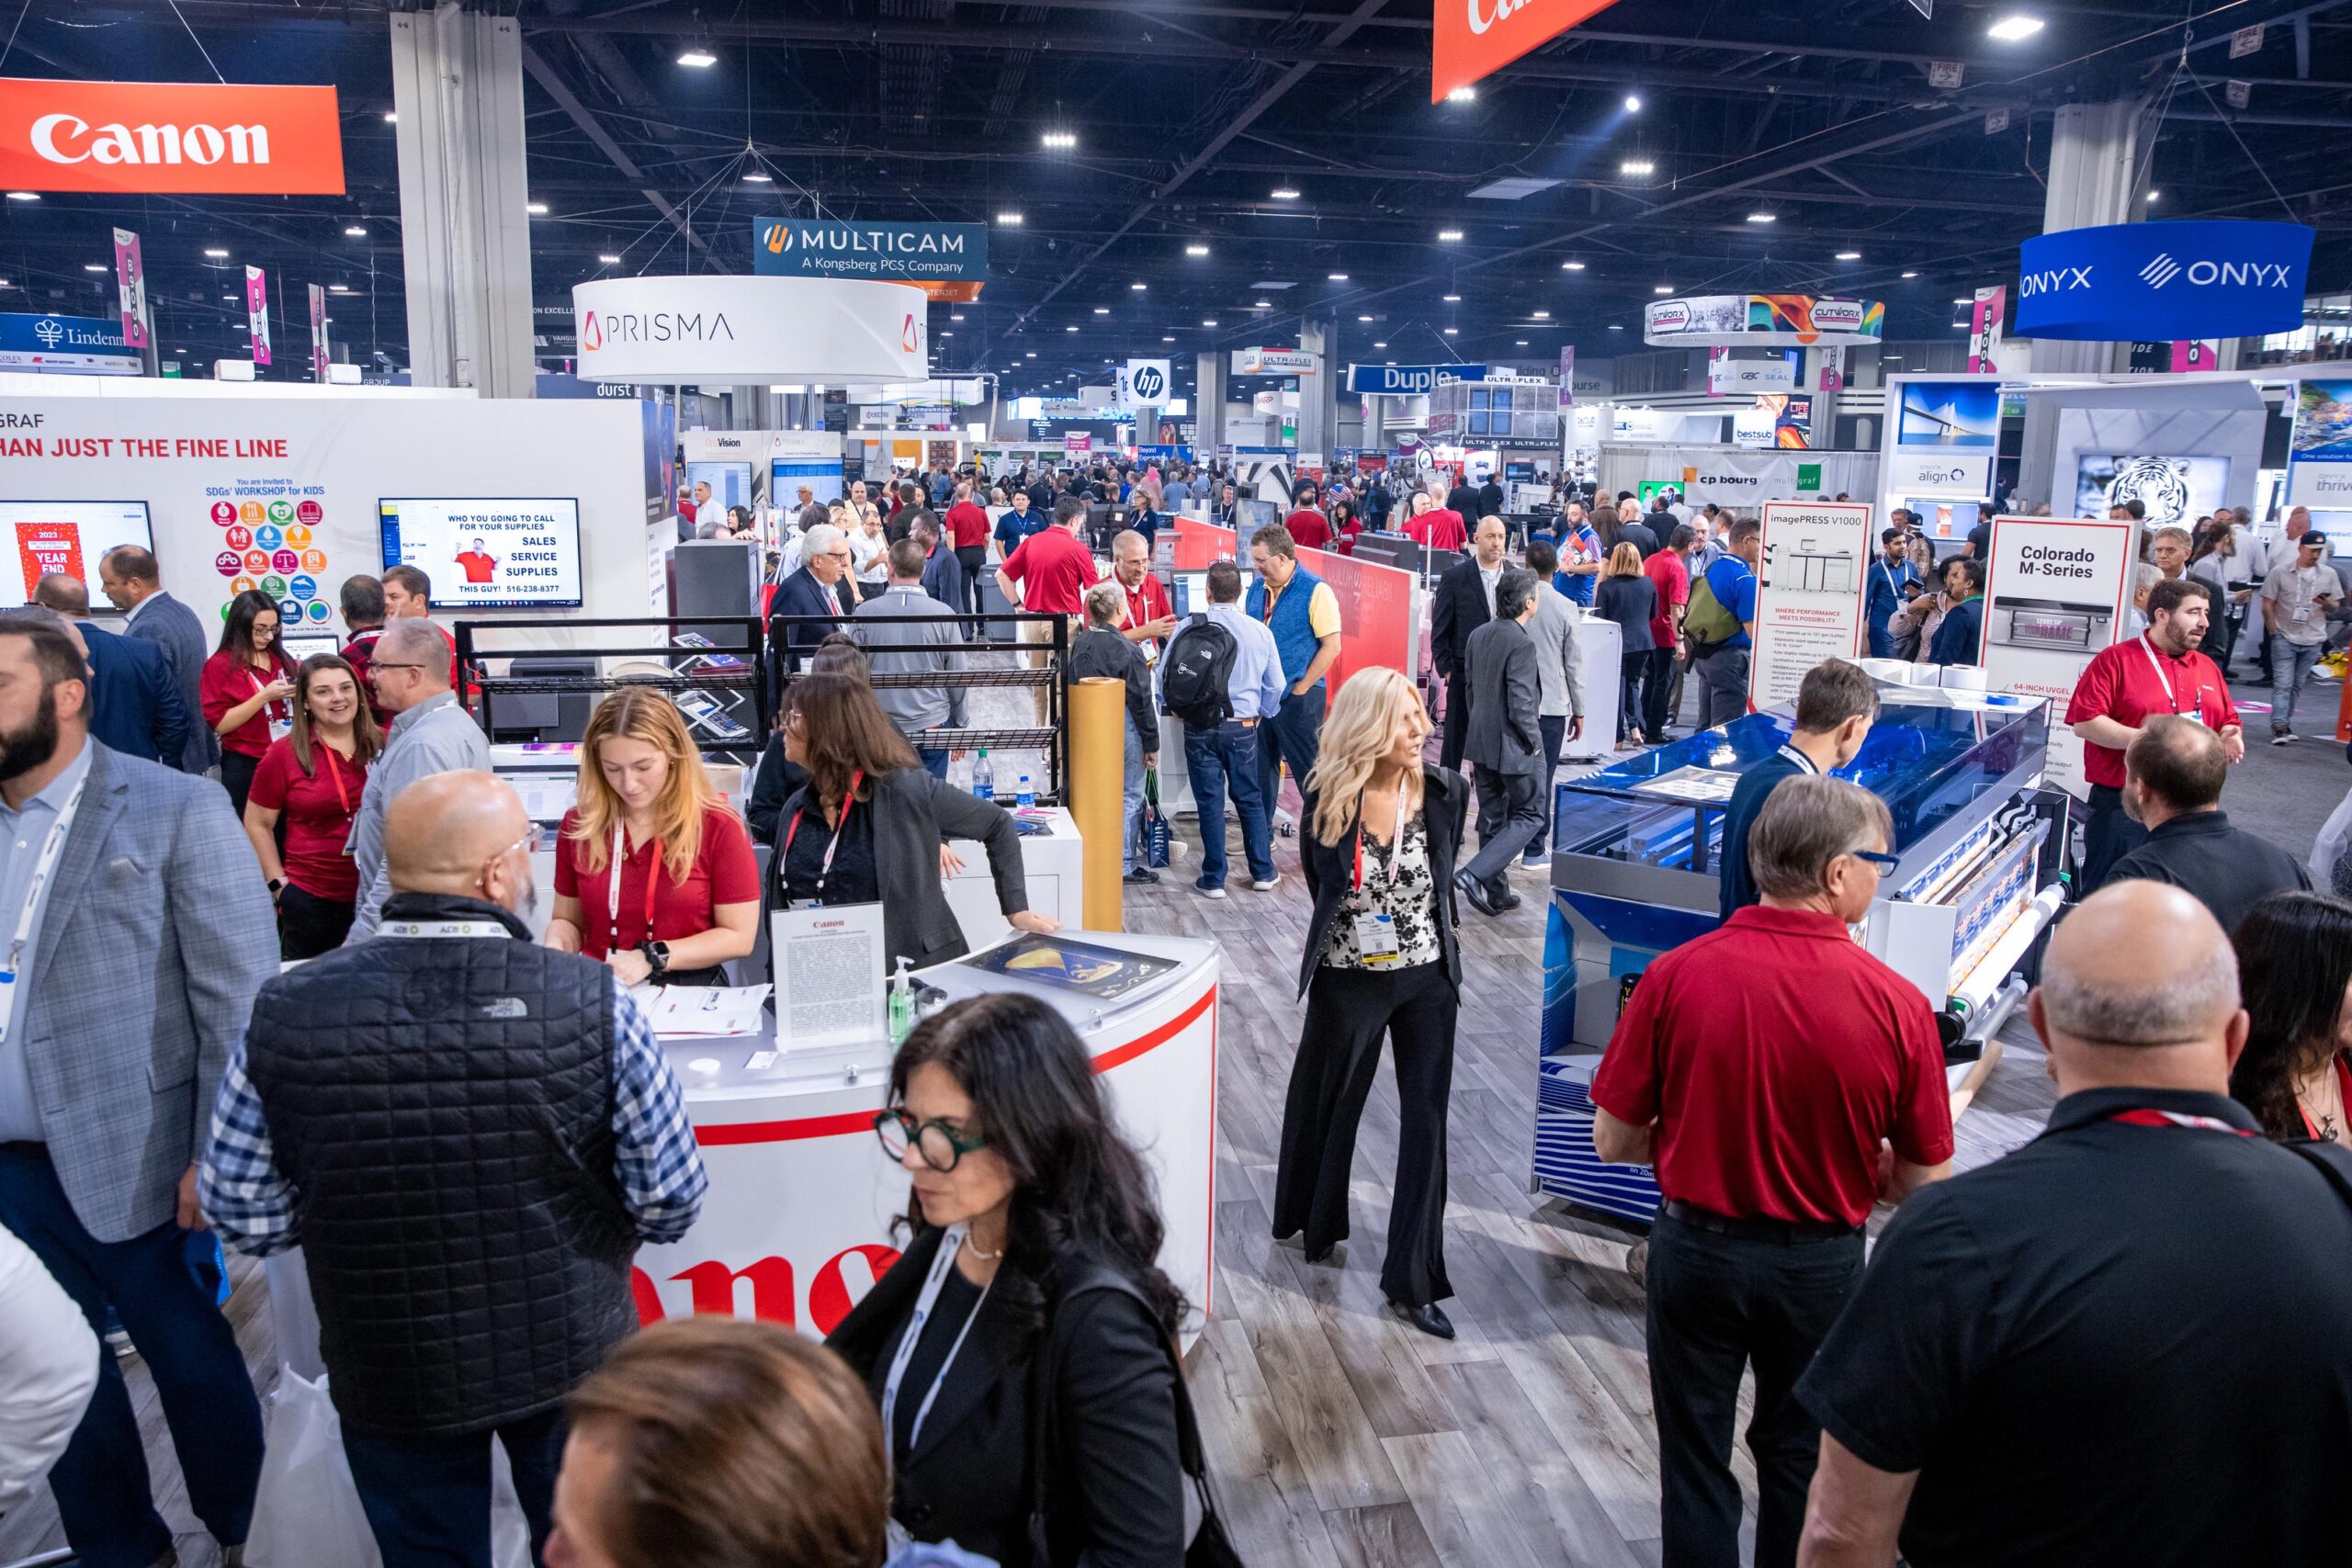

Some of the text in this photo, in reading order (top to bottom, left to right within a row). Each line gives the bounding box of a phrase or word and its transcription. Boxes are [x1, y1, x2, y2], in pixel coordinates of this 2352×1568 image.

[30, 113, 270, 165] Canon
[801, 230, 965, 254] MULTICAM
[802, 256, 964, 275] A Kongsberg PCS Company
[2188, 260, 2291, 289] ONYX
[2021, 265, 2094, 299] ONYX
[923, 288, 958, 299] ATERJET
[1815, 306, 1860, 319] CUTWORX
[606, 312, 734, 344] PRISMA
[2132, 344, 2154, 353] IDE
[1136, 366, 1160, 399] hp
[597, 383, 632, 398] durst
[1790, 404, 1809, 412] LIFE
[1736, 429, 1772, 439] bestsub
[51, 438, 114, 458] JUST
[120, 438, 170, 458] THE
[175, 439, 229, 458] FINE
[235, 439, 288, 458] LINE
[1700, 474, 1758, 486] cp bourg
[1918, 470, 1949, 484] align
[235, 486, 287, 496] WORKSHOP
[288, 487, 300, 495] for
[303, 486, 325, 495] KIDS
[1770, 513, 1861, 527] imagePRESS V1000
[459, 523, 545, 531] FOR YOUR SUPPLIES
[522, 536, 557, 546] SALES
[36, 553, 68, 564] YEAR
[511, 551, 558, 561] SERVICE
[2020, 545, 2096, 563] Colorado
[506, 567, 559, 577] SUPPLIES
[2018, 561, 2094, 580] M-Series
[506, 585, 560, 593] 516-238-8377
[1795, 609, 1842, 617] PERFORMANCE
[2014, 683, 2044, 693] 64-INCH
[2046, 686, 2071, 695] UVGEL
[813, 920, 844, 929] Canon
